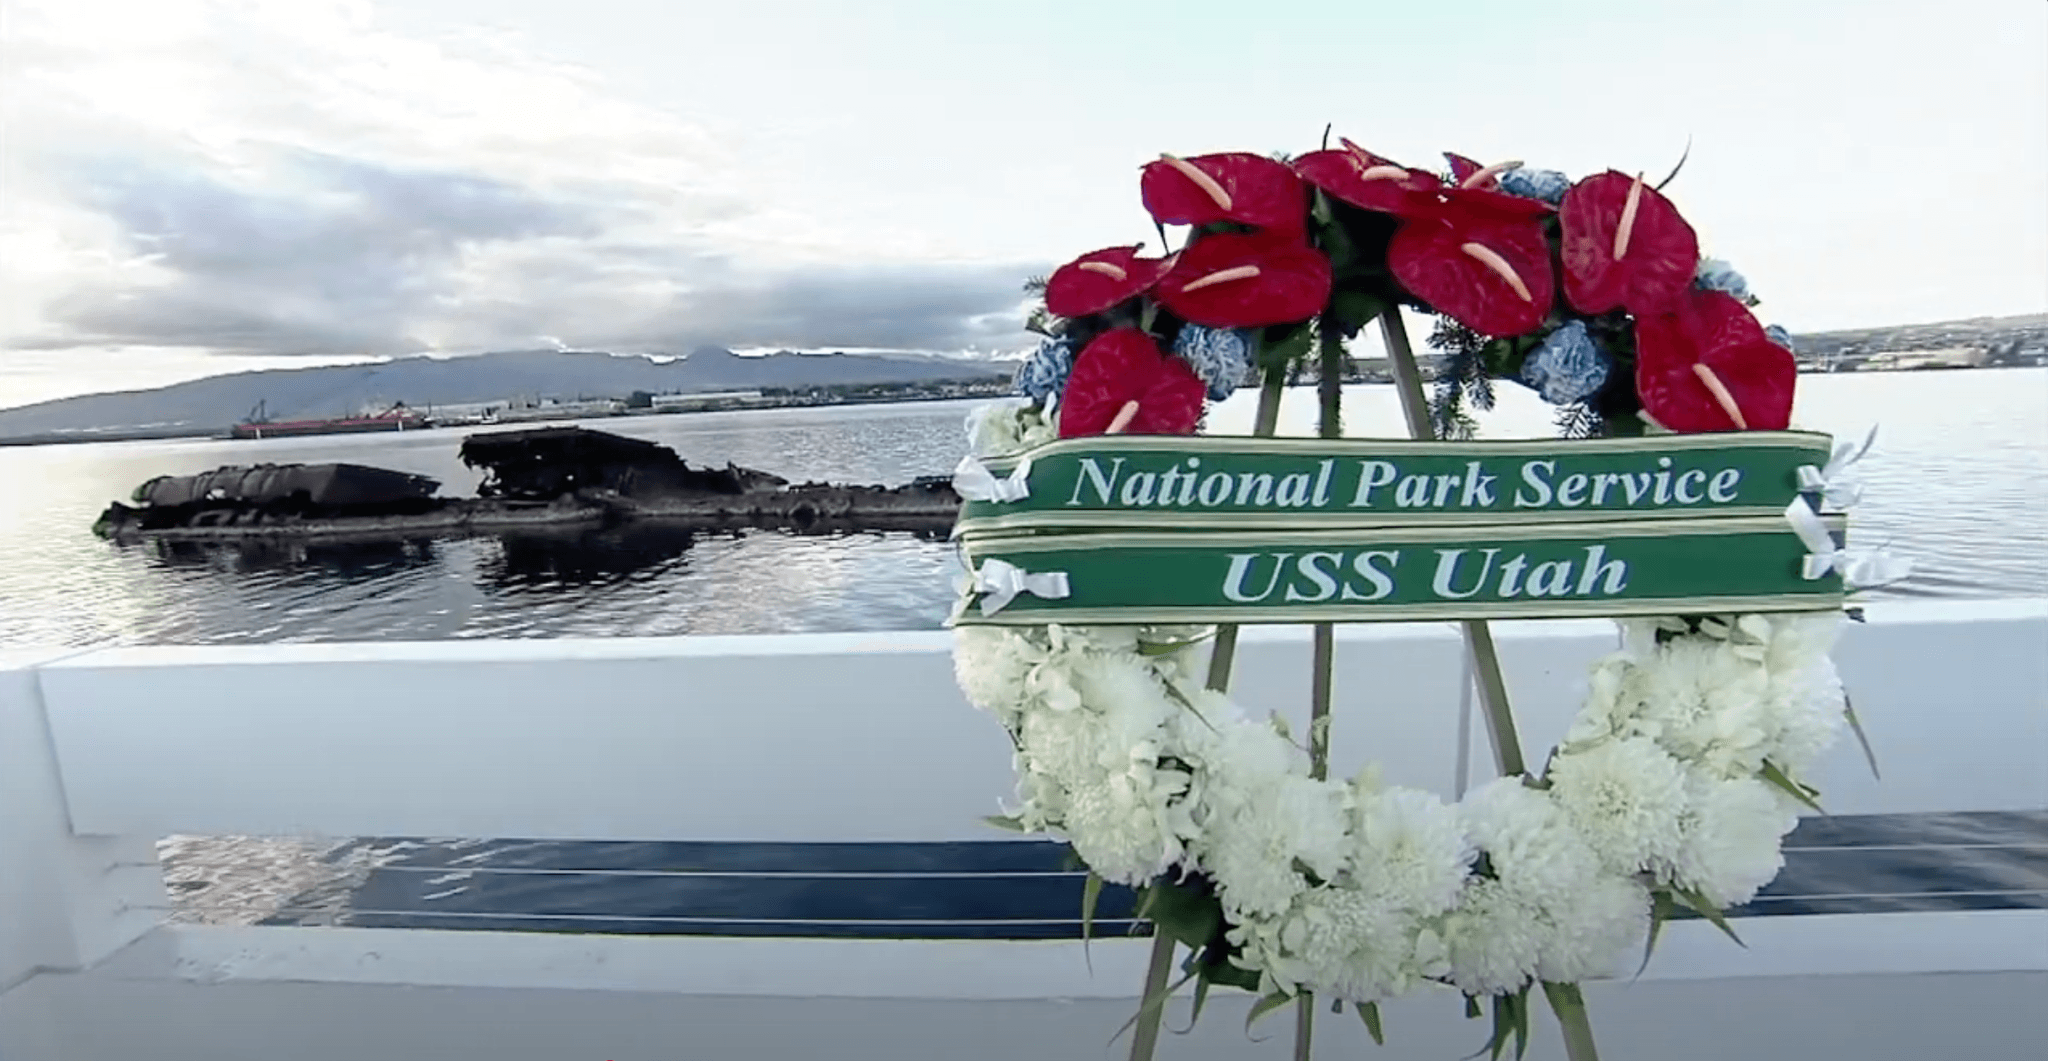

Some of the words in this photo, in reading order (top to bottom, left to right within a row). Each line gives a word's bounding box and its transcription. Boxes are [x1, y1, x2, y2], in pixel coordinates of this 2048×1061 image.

[1067, 456, 1331, 507] National
[1352, 460, 1498, 508] Park
[1513, 459, 1740, 508] Service
[1221, 550, 1400, 602] USS
[1431, 544, 1629, 599] Utah
